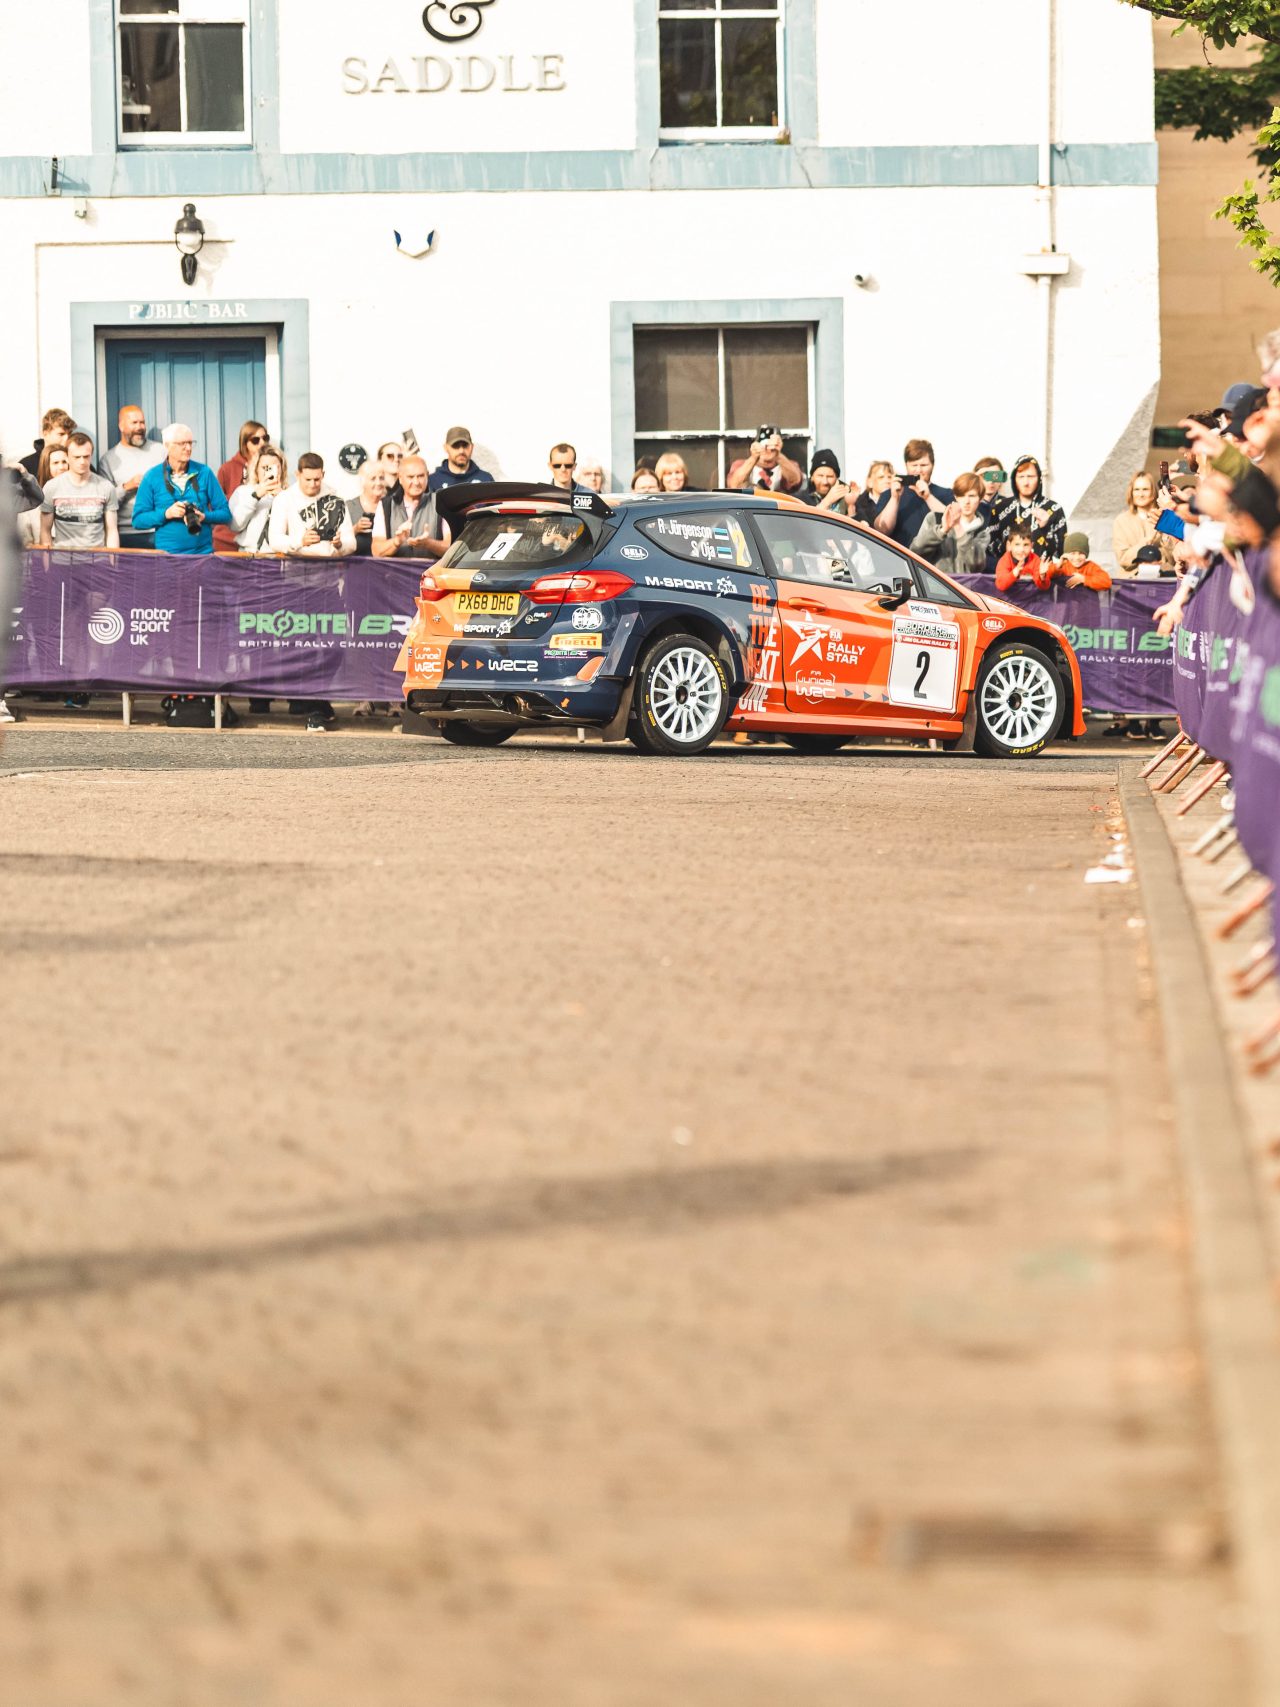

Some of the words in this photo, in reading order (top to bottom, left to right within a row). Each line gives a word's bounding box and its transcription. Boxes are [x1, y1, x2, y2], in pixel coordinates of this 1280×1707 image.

[341, 55, 567, 95] SADDLE
[128, 303, 197, 319] PUBLIC
[208, 302, 248, 318] BAR
[573, 497, 592, 507] OMP
[669, 521, 713, 541] Jürgenson
[490, 541, 506, 559] 2
[624, 549, 645, 558] BELL
[701, 544, 716, 561] Oja
[458, 594, 488, 610] PX68
[490, 595, 514, 611] DHG
[749, 583, 772, 613] BE
[130, 607, 175, 620] motor
[910, 605, 938, 615] PROBITE
[130, 620, 170, 634] sport
[239, 609, 348, 638] PROBITE
[748, 614, 777, 648] THE
[984, 619, 1003, 629] BELL
[130, 633, 149, 645] UK
[238, 640, 290, 648] BRITISH
[295, 640, 335, 649] RALLY
[828, 642, 865, 657] RALLY
[826, 652, 858, 665] STAR
[1080, 655, 1115, 663] RALLY
[913, 651, 931, 699] 2
[738, 681, 772, 713] ONE
